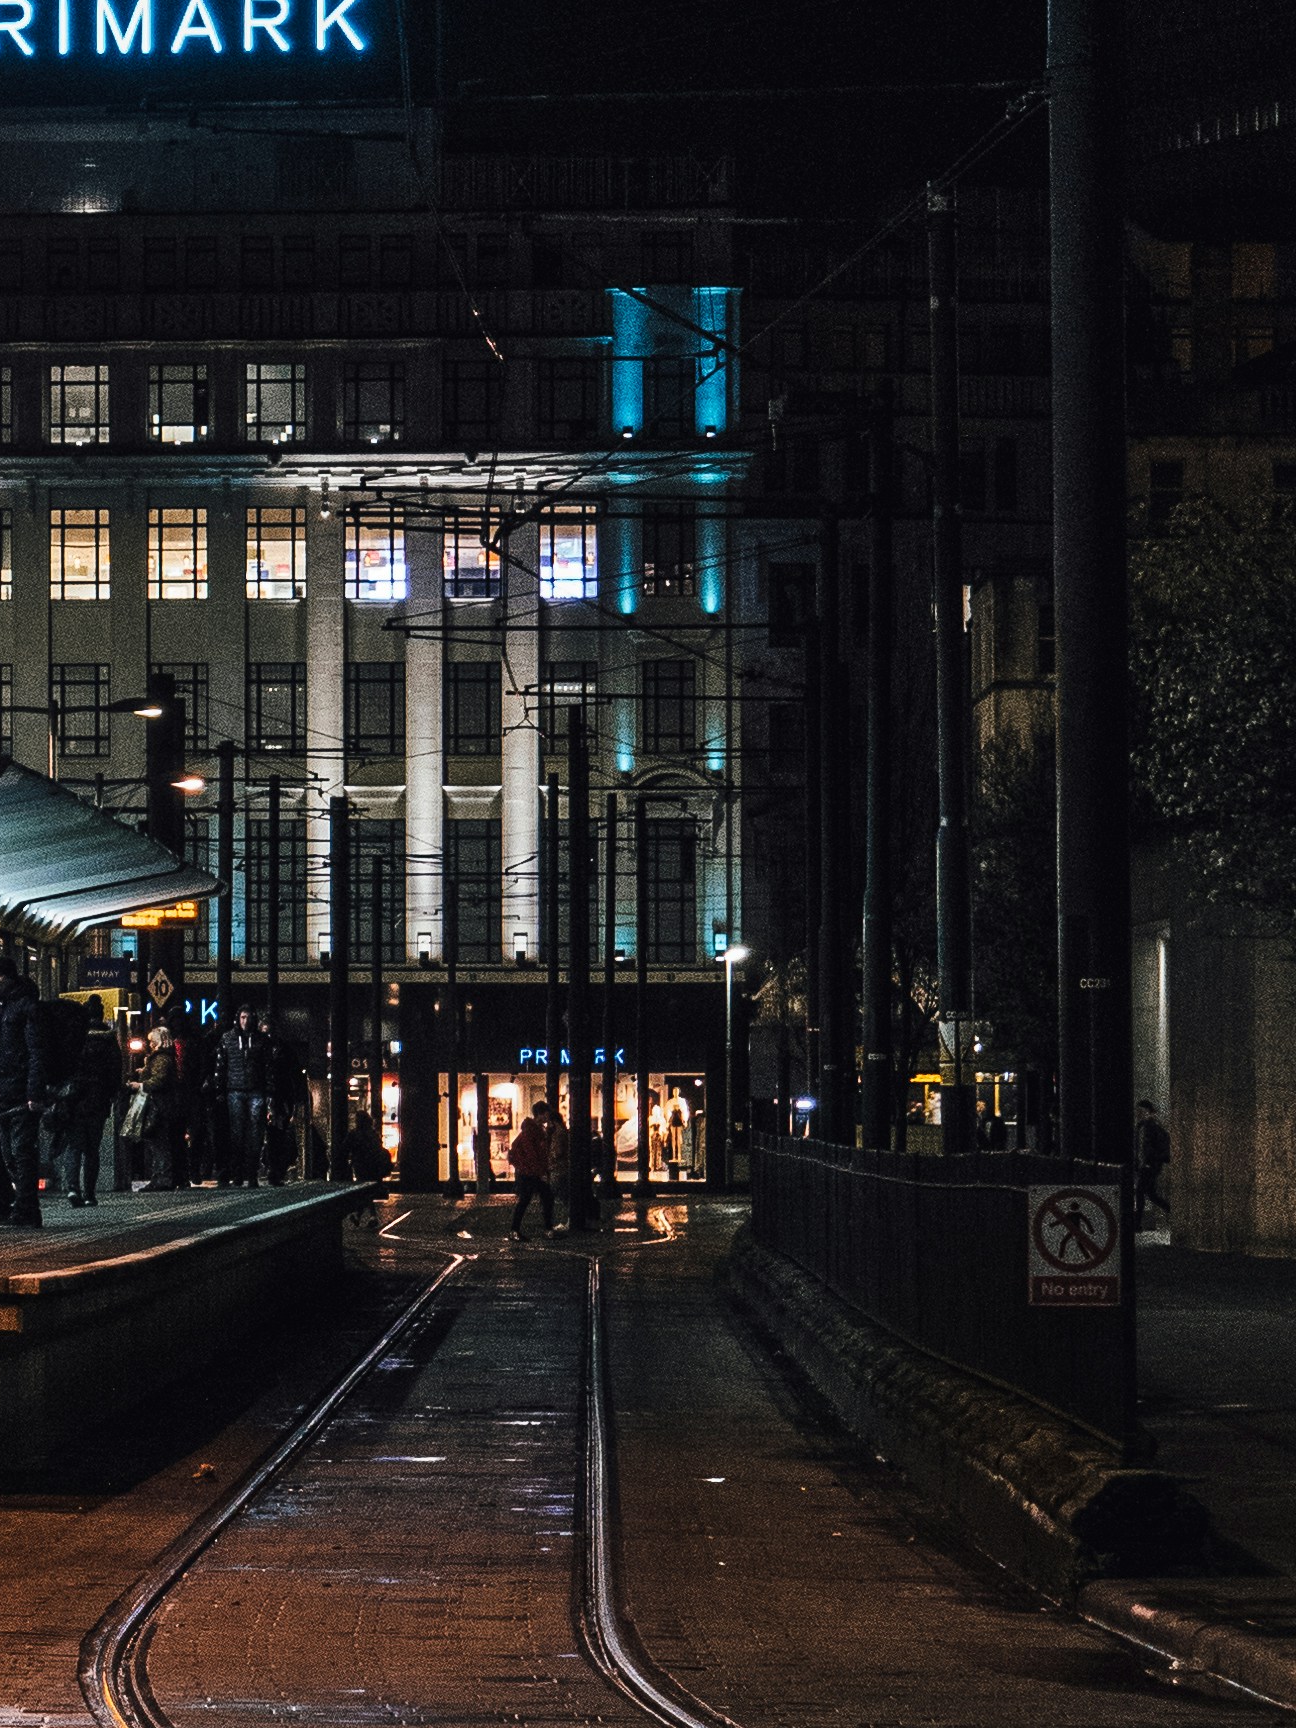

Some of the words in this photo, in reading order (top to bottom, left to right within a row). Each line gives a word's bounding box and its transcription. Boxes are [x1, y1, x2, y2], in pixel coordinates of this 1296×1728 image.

[154, 980, 169, 997] 10
[1040, 1281, 1066, 1297] No
[1068, 1283, 1109, 1301] entry
